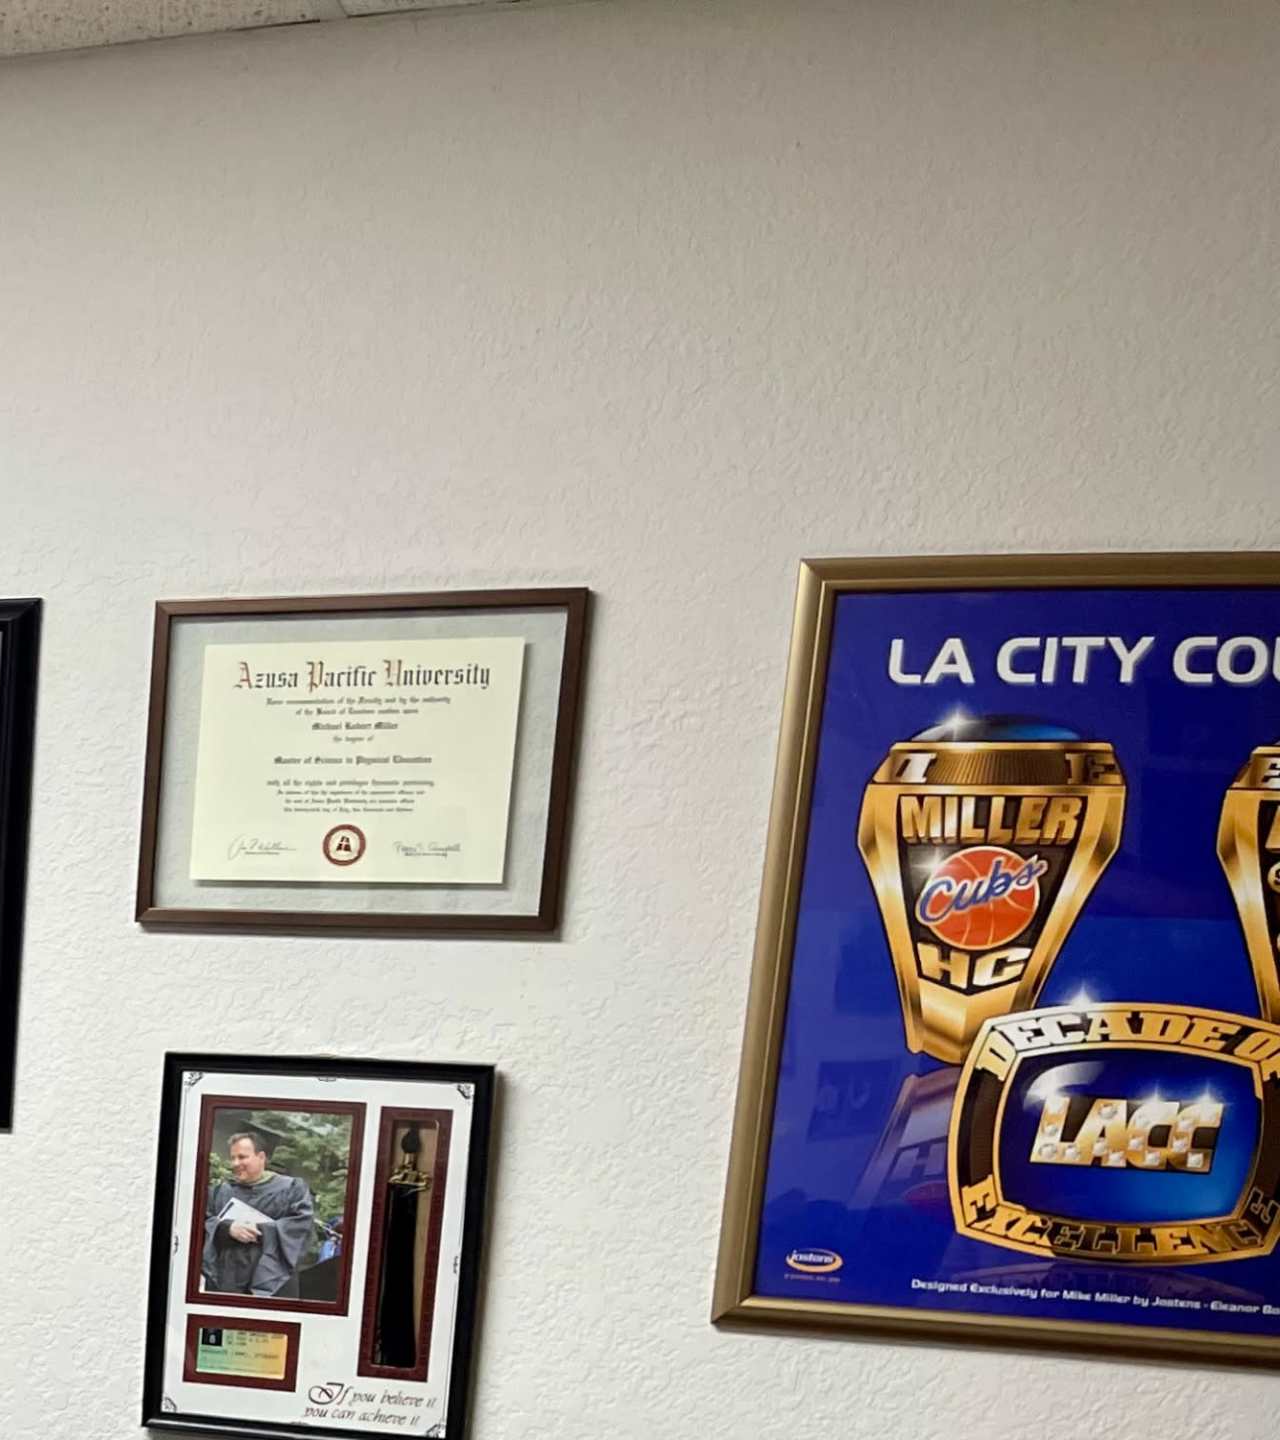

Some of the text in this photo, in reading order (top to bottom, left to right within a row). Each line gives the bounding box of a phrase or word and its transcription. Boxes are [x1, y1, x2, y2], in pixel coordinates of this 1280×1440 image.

[233, 659, 491, 693] Azusa Pacific University
[889, 636, 1280, 684] LA CITY CO
[900, 796, 1082, 844] MILLER
[917, 855, 1046, 923] Cubs
[917, 943, 1032, 989] HC
[975, 1011, 1244, 1082] DECADE
[1030, 1096, 1224, 1174] LACC
[961, 1174, 1279, 1252] EXCELLENCE
[912, 1278, 967, 1293] Designed
[970, 1283, 1038, 1299] Exclusively
[1041, 1286, 1059, 1298] for
[1062, 1290, 1091, 1301] Mike
[1095, 1292, 1130, 1304] Miller
[1133, 1296, 1149, 1307] by
[1152, 1297, 1201, 1309] Jostens
[304, 1407, 328, 1418] you
[331, 1410, 355, 1420] can
[358, 1408, 406, 1425] achieve
[350, 1393, 376, 1406] you
[381, 1389, 424, 1408] believe
